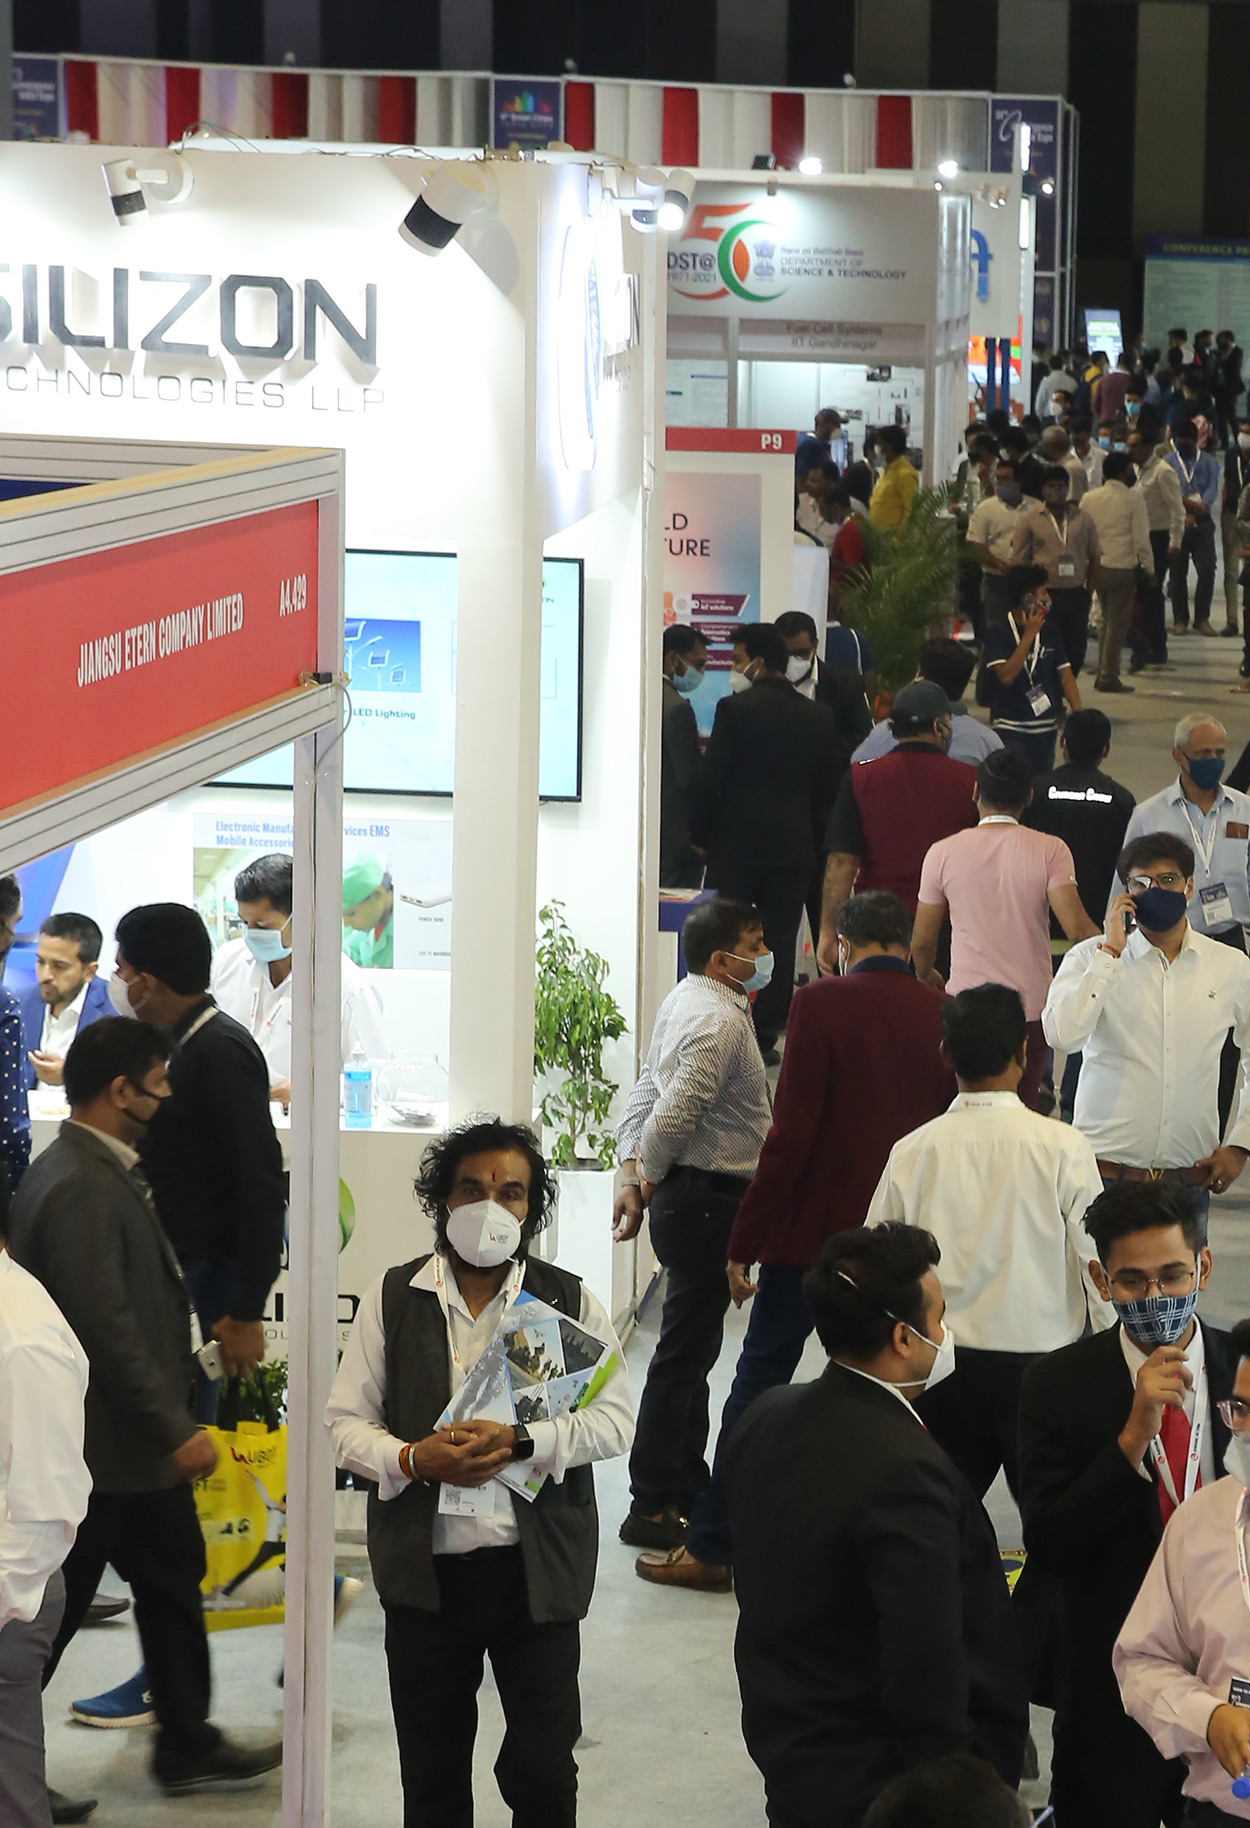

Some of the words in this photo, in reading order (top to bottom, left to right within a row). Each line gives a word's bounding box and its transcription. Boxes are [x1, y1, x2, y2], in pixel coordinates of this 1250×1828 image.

[780, 268, 824, 277] SCIENCE
[837, 269, 907, 280] TECHNOLOGY
[0, 263, 377, 366] ILIZON
[837, 325, 882, 336] Systems
[311, 385, 385, 412] LLP
[761, 433, 783, 450] P9
[77, 632, 122, 688] JIANGSU
[124, 620, 156, 671] ETERN
[158, 604, 205, 659] COMPANY
[207, 592, 244, 641] LIMITED
[280, 573, 307, 617] A4.429
[353, 708, 373, 717] LED
[375, 708, 416, 719] Lighting
[215, 820, 261, 833] Electronic
[369, 825, 390, 837] EMS
[216, 835, 247, 846] Mobile
